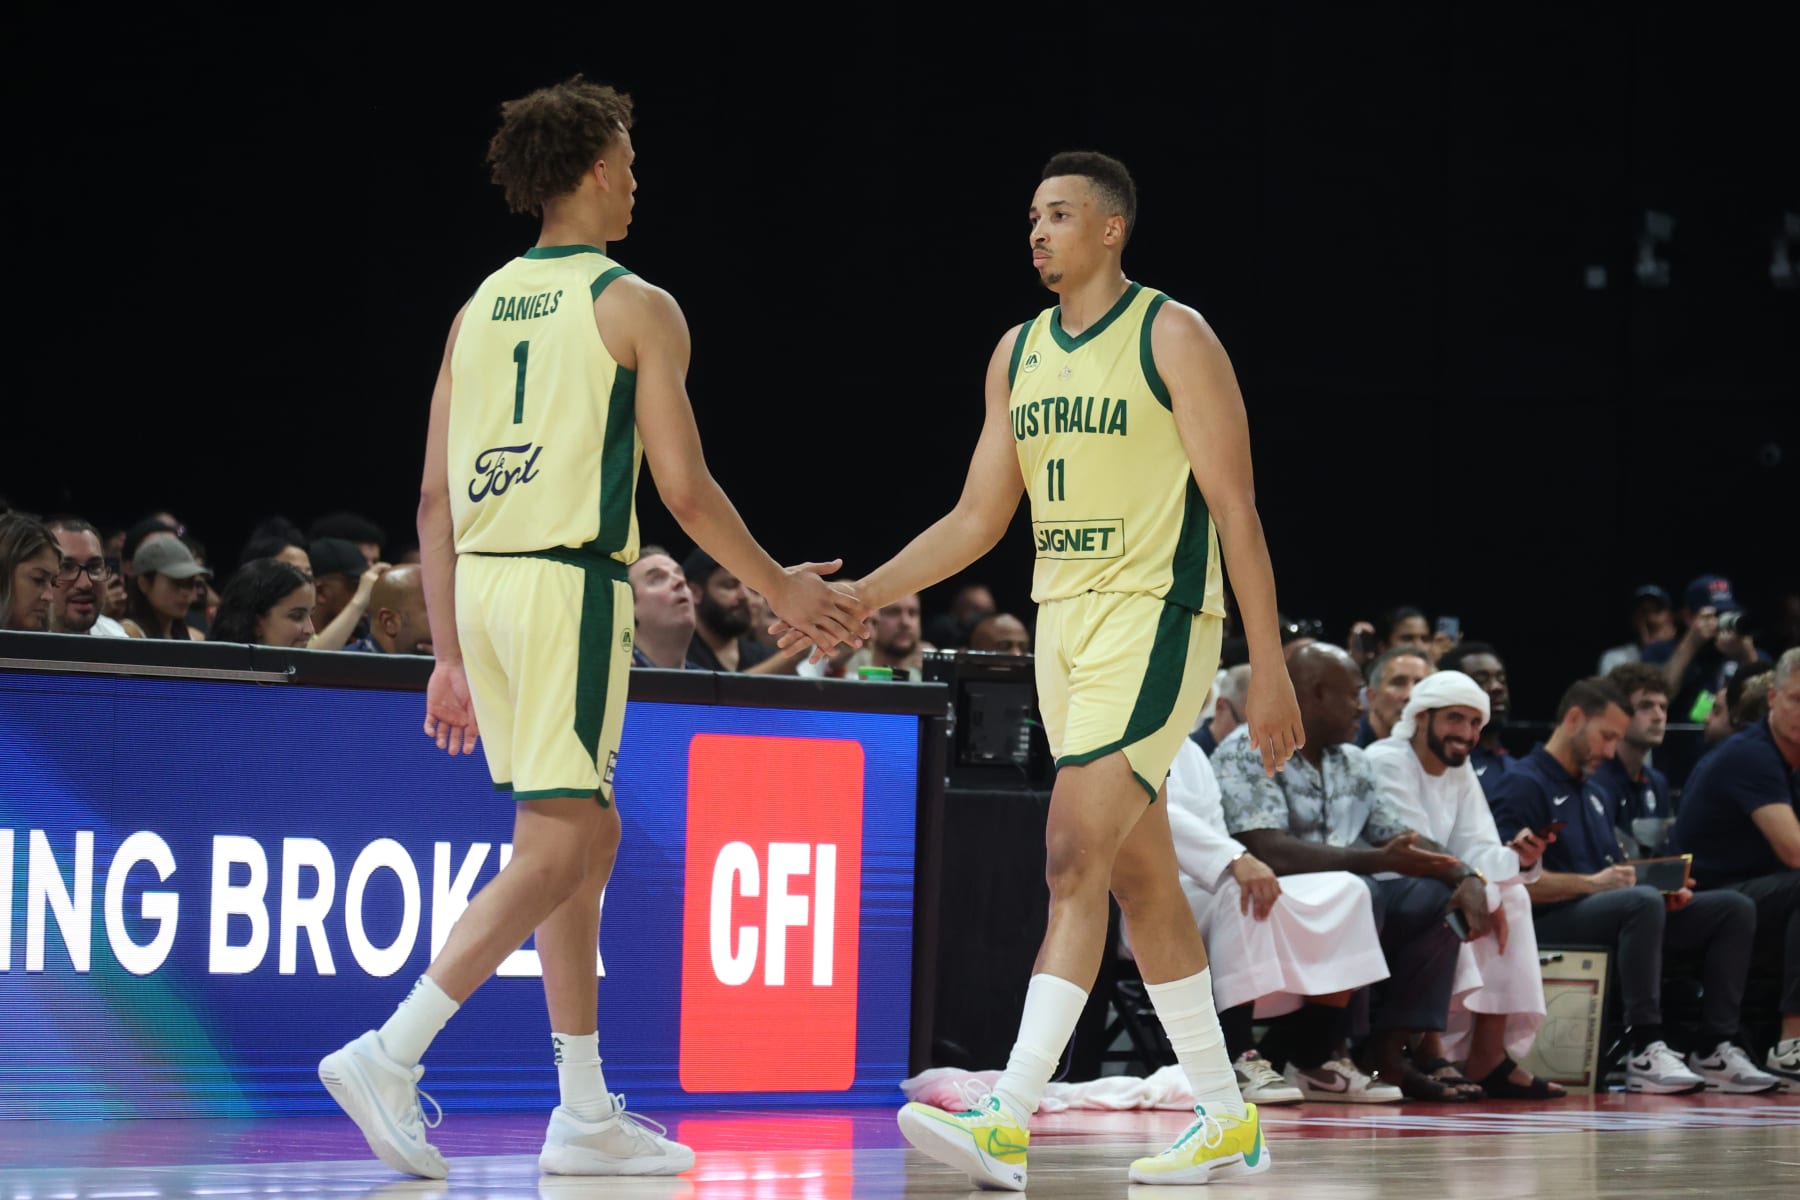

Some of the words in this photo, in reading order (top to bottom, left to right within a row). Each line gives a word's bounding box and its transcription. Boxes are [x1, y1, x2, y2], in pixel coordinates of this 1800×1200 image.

[491, 289, 563, 321] DANIELS
[513, 340, 530, 425] 1
[1010, 396, 1127, 441] USTRALIA
[468, 442, 543, 503] Ford
[1046, 458, 1065, 502] 11
[208, 835, 606, 978] BROK
[709, 841, 838, 987] CFI
